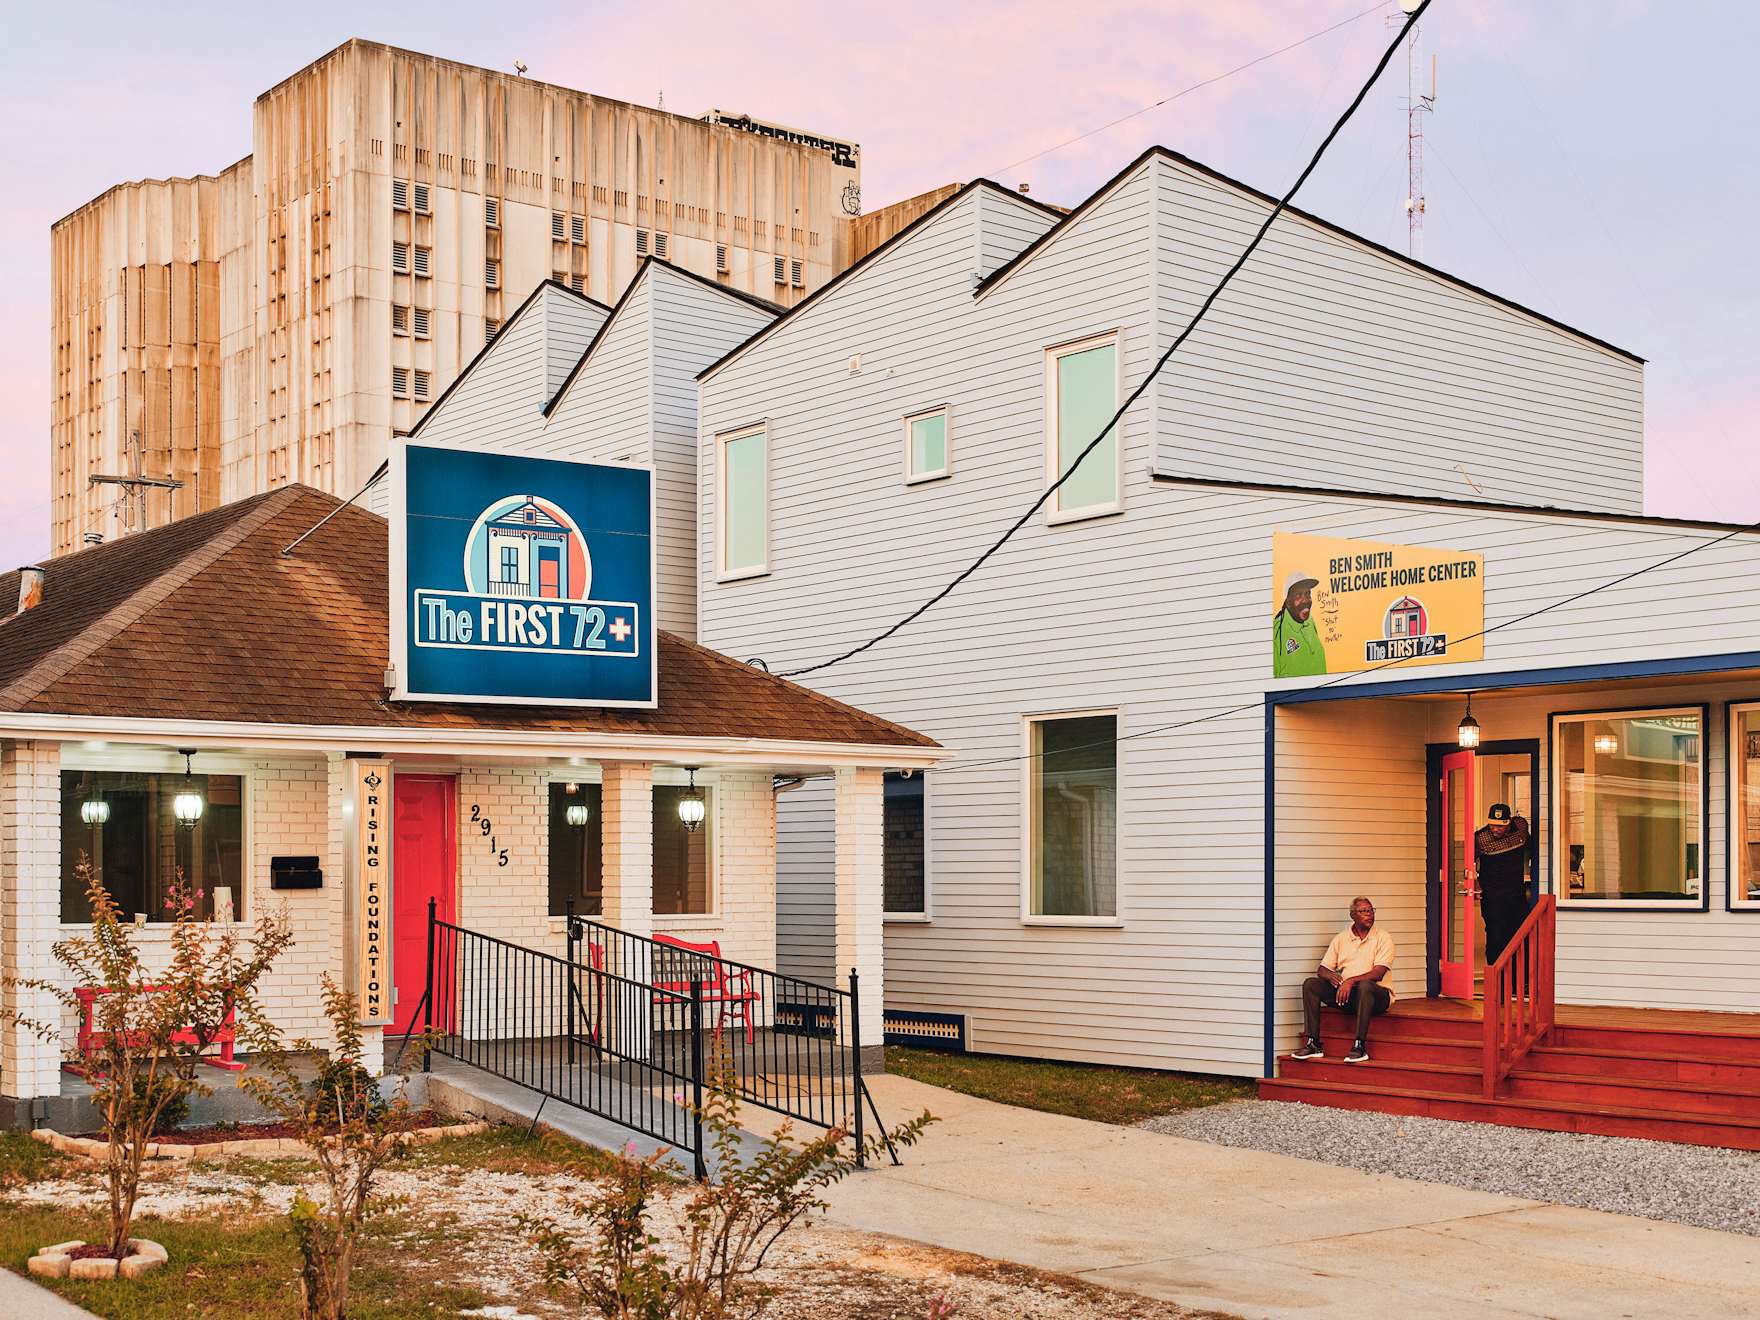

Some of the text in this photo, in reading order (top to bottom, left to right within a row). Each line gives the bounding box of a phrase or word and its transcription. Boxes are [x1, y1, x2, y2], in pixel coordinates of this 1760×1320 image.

[1330, 551, 1393, 575] BEN SMITH
[1330, 560, 1477, 594] WELCOME HOME CENTER
[422, 597, 473, 644] The
[480, 601, 564, 646] FIRST
[1367, 642, 1386, 660] The
[1387, 639, 1419, 658] FIRST
[471, 804, 509, 867] 2915
[367, 795, 380, 1016] RISING FOUNDATIONS
